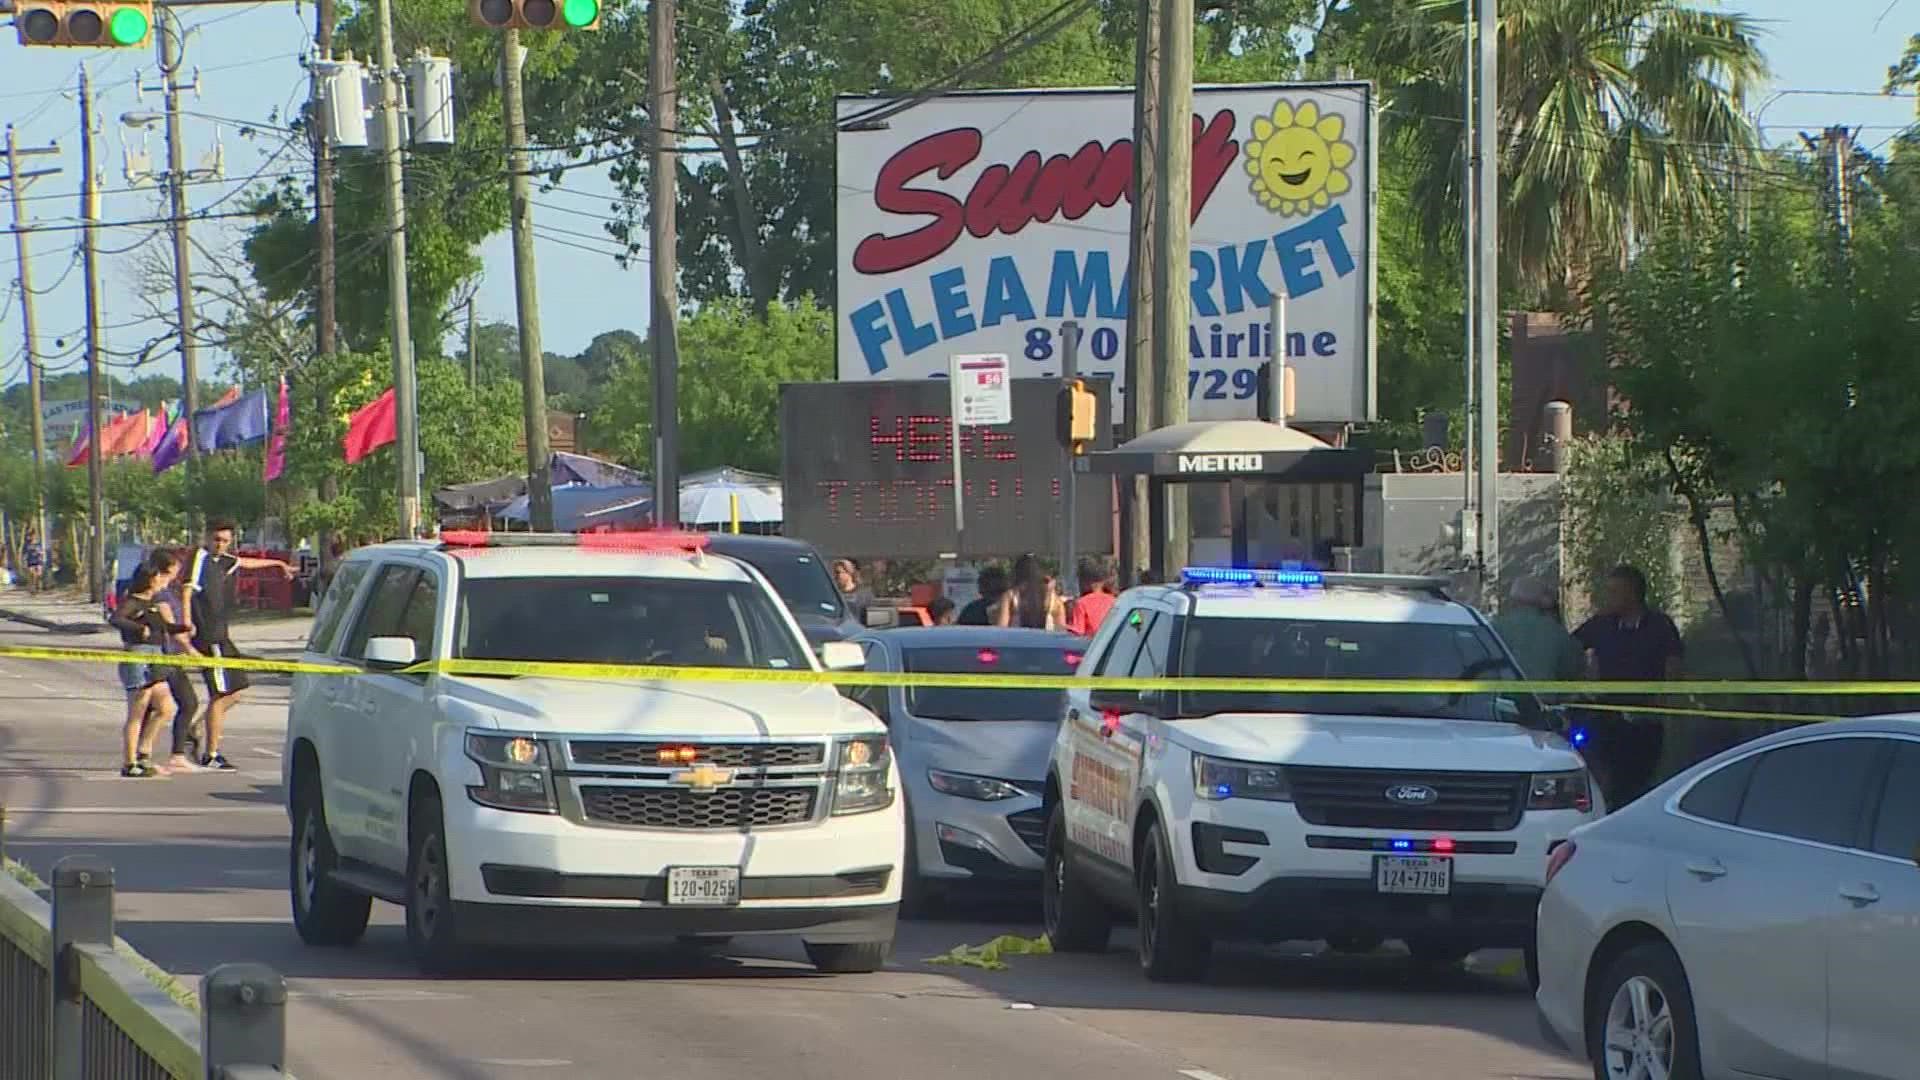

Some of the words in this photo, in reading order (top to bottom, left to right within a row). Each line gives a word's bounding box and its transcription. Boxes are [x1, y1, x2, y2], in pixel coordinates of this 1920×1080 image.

[853, 109, 1239, 275] Sunny
[849, 255, 1035, 375] FLEA
[1179, 454, 1263, 472] METRO
[1397, 785, 1427, 799] Ford
